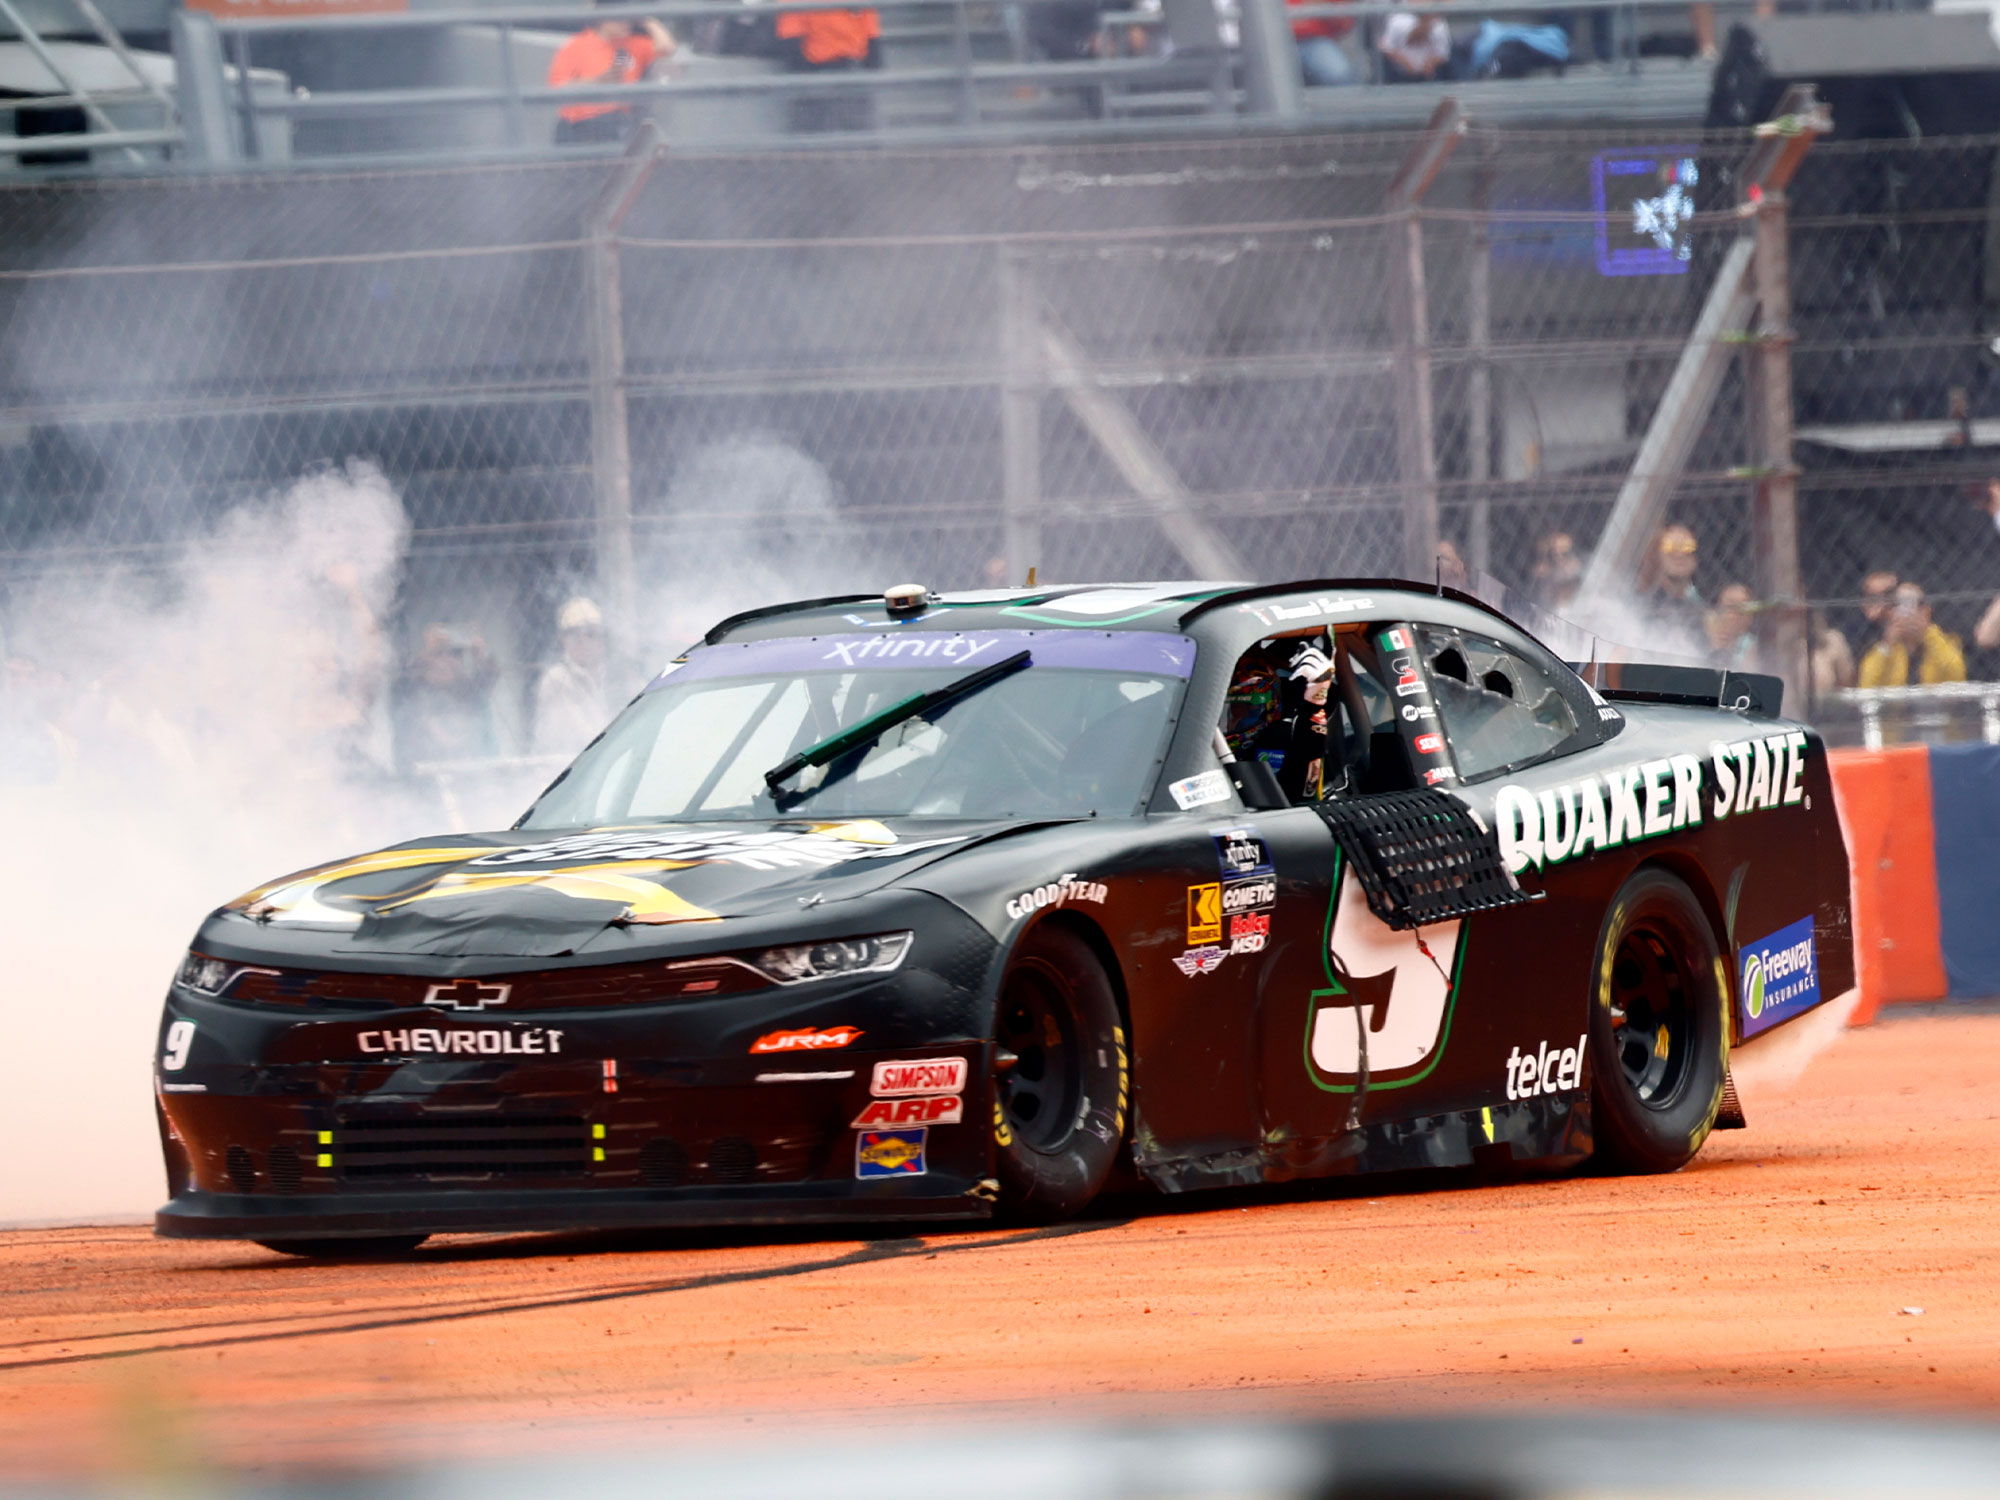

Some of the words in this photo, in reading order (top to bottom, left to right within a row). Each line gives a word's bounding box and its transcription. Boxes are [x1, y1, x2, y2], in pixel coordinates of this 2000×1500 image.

[822, 631, 1000, 666] xfinity
[1494, 753, 1702, 875] QUAKER
[1006, 873, 1108, 919] GOODYEAR
[1222, 883, 1275, 909] COMETIC
[1230, 935, 1265, 955] MSD
[1762, 938, 1812, 985] Freeway
[1765, 974, 1815, 1010] INSURANCE
[163, 1020, 195, 1070] 9
[357, 1028, 565, 1054] CHEVROLET
[758, 1032, 849, 1049] JRM
[881, 1064, 960, 1090] SIMPSON
[1505, 1033, 1588, 1100] telcel
[858, 1097, 959, 1124] ARP
